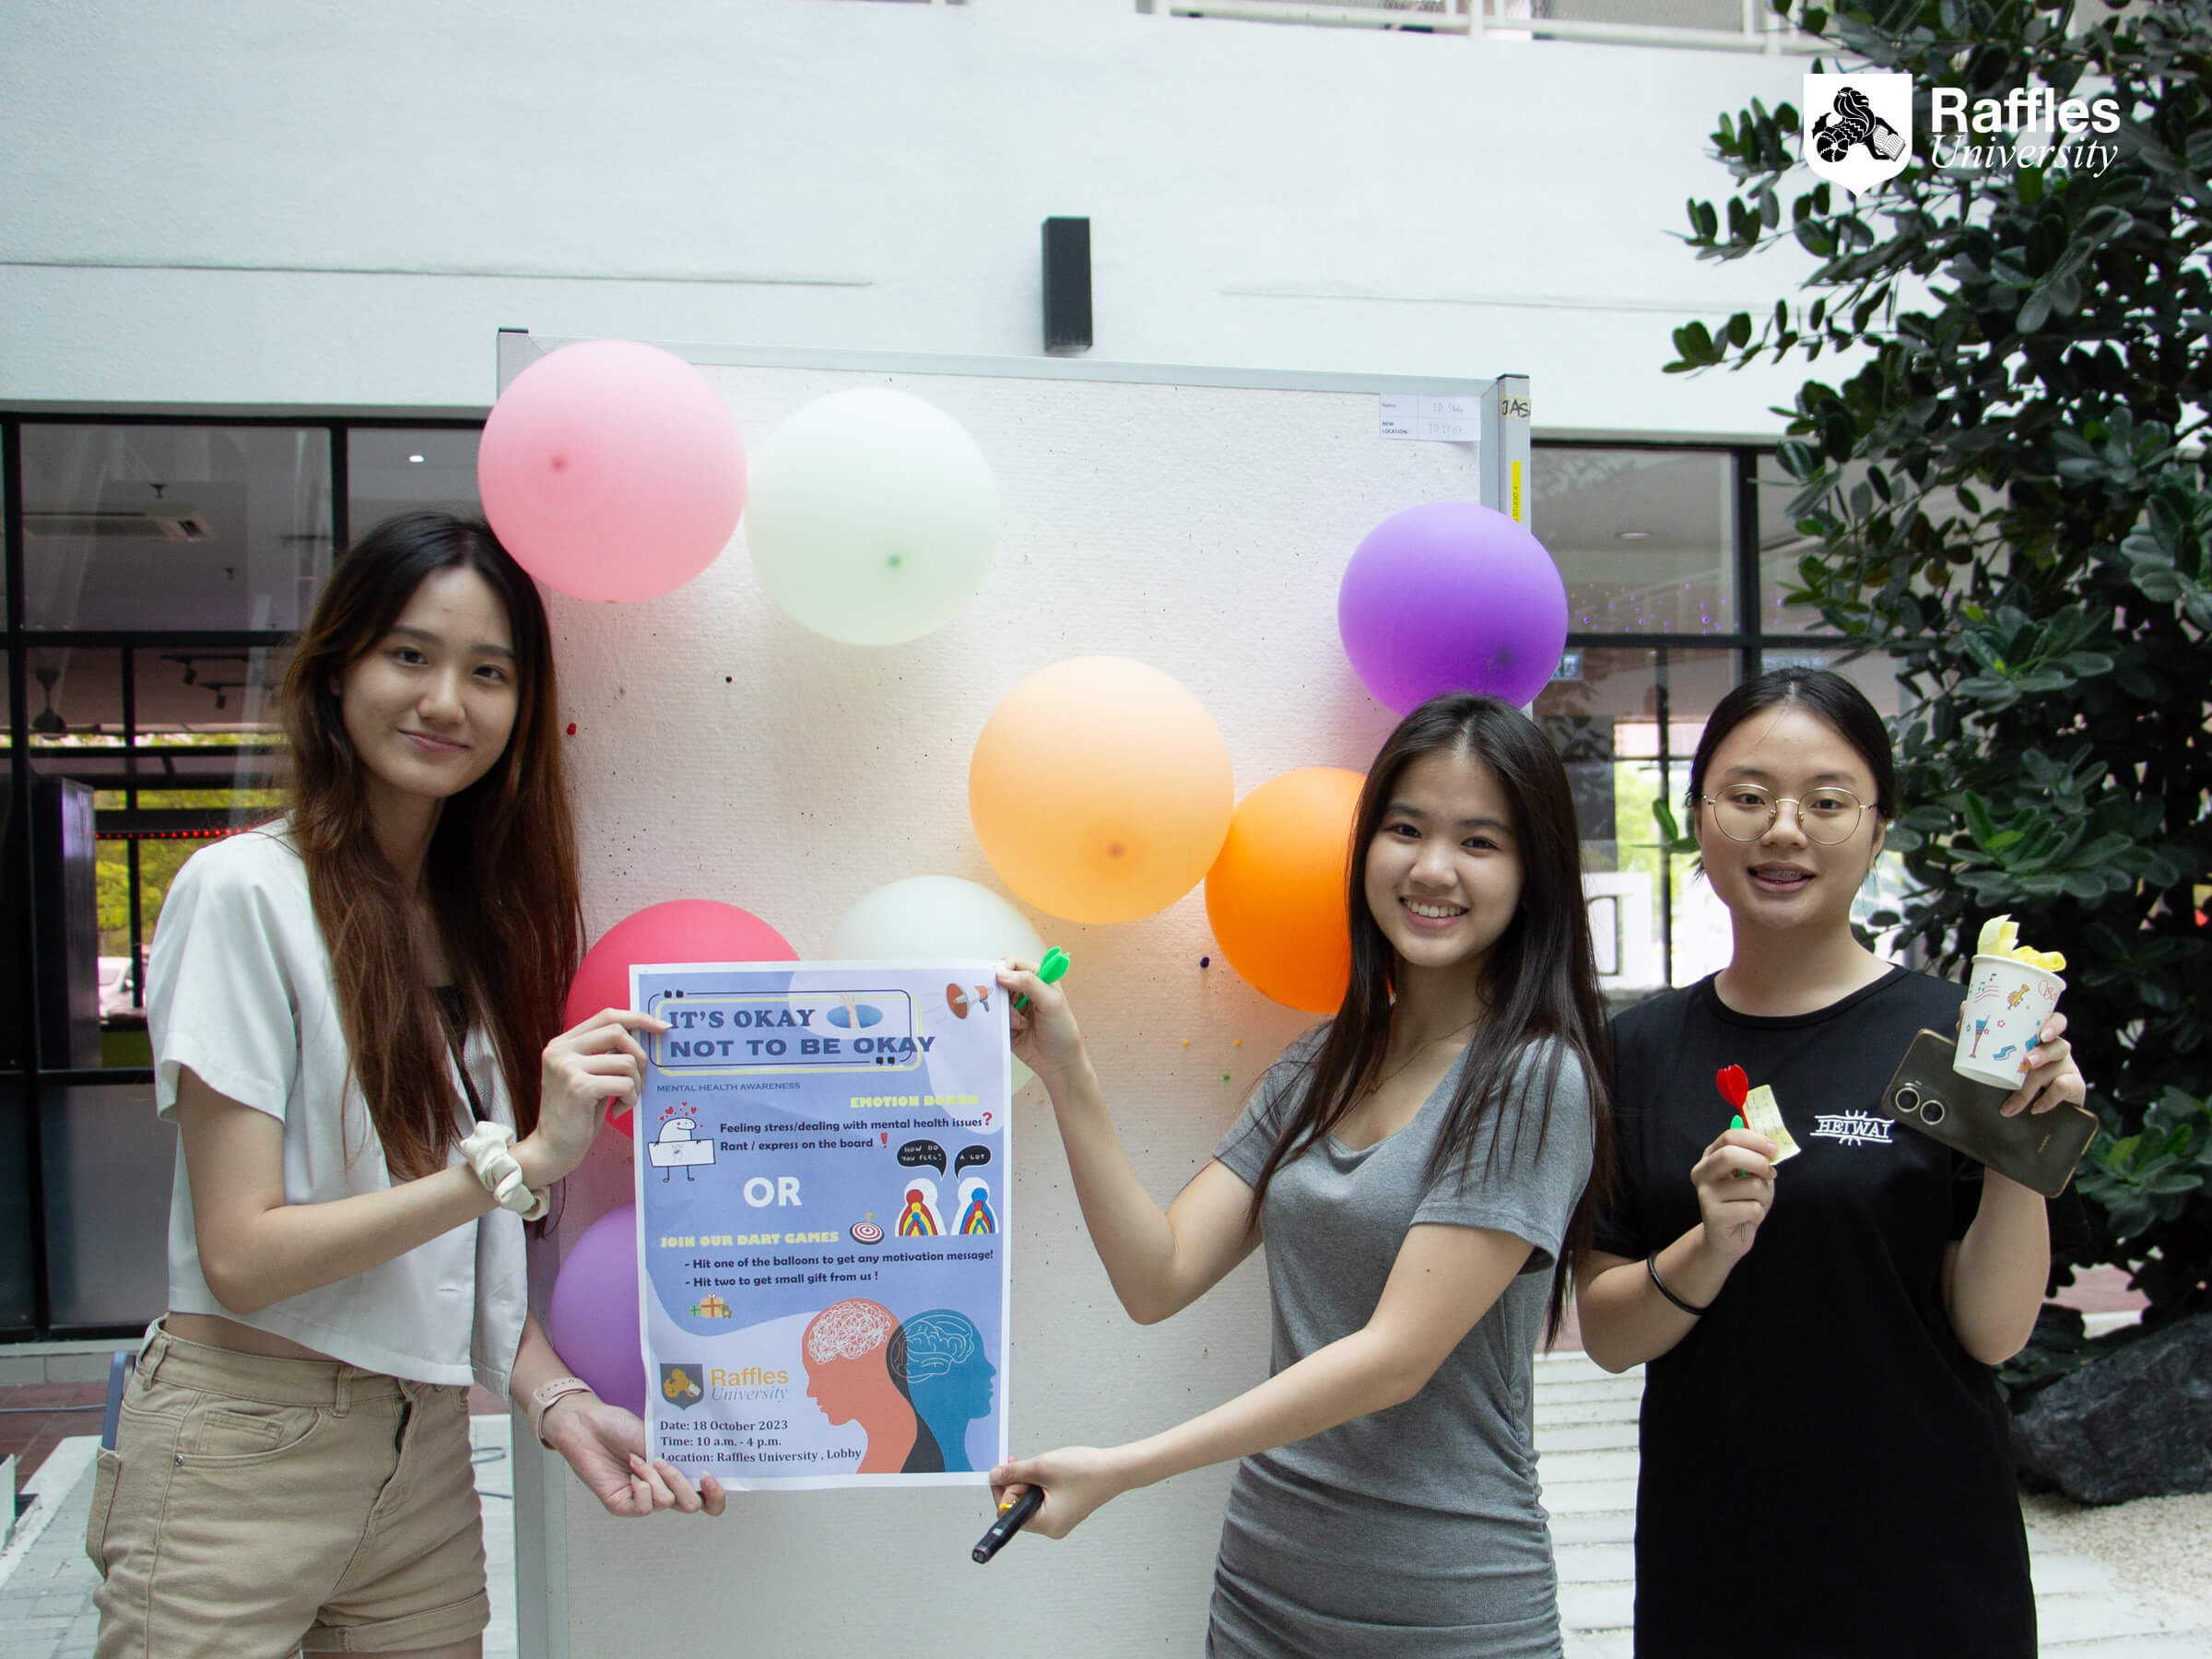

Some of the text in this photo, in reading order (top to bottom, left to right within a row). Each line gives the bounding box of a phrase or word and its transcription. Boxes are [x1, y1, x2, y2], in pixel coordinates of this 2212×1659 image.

[734, 1009, 816, 1029] OKAY
[670, 1036, 936, 1058] NOT TO BE OKAY
[656, 1082, 801, 1092] MENTAL HEALTH AWARENESS
[850, 1094, 980, 1108] EMOTION BOARD
[720, 1124, 761, 1134] Feeling
[764, 1121, 840, 1133] stress/dealing
[843, 1120, 868, 1130] with
[871, 1119, 911, 1129] mental
[913, 1118, 949, 1128] health
[720, 1141, 748, 1151] Rant
[751, 1140, 756, 1151] /
[759, 1141, 799, 1151] express
[802, 1141, 816, 1149] on
[818, 1139, 838, 1149] the
[840, 1138, 874, 1147] board
[743, 1176, 803, 1208] OR
[661, 1231, 840, 1248] JOIN OUR DART GAMES
[692, 1259, 712, 1269] Hit
[713, 1260, 735, 1268] one
[737, 1257, 749, 1267] of
[751, 1257, 771, 1267] the
[773, 1256, 819, 1266] balloons
[822, 1255, 834, 1265] to
[837, 1254, 855, 1265] get
[858, 1254, 879, 1264] any
[882, 1253, 944, 1262] motivation
[947, 1250, 994, 1261] message!
[693, 1277, 712, 1287] Hit
[714, 1277, 736, 1287] two
[738, 1276, 751, 1286] to
[753, 1276, 772, 1288] get
[775, 1274, 805, 1284] small
[807, 1273, 828, 1285] gift
[830, 1272, 856, 1282] from
[711, 1368, 789, 1386] Raffles
[711, 1386, 789, 1402] University
[660, 1419, 788, 1431] Date: 18 October 2023
[660, 1436, 693, 1446] Time:
[697, 1436, 711, 1446] 10
[713, 1438, 737, 1446] a.m.
[746, 1436, 754, 1446] 4
[757, 1438, 782, 1449] p.m.
[661, 1452, 713, 1462] Location:
[716, 1452, 756, 1463] Raffles
[759, 1450, 818, 1462] University
[827, 1448, 862, 1460] Lobby
